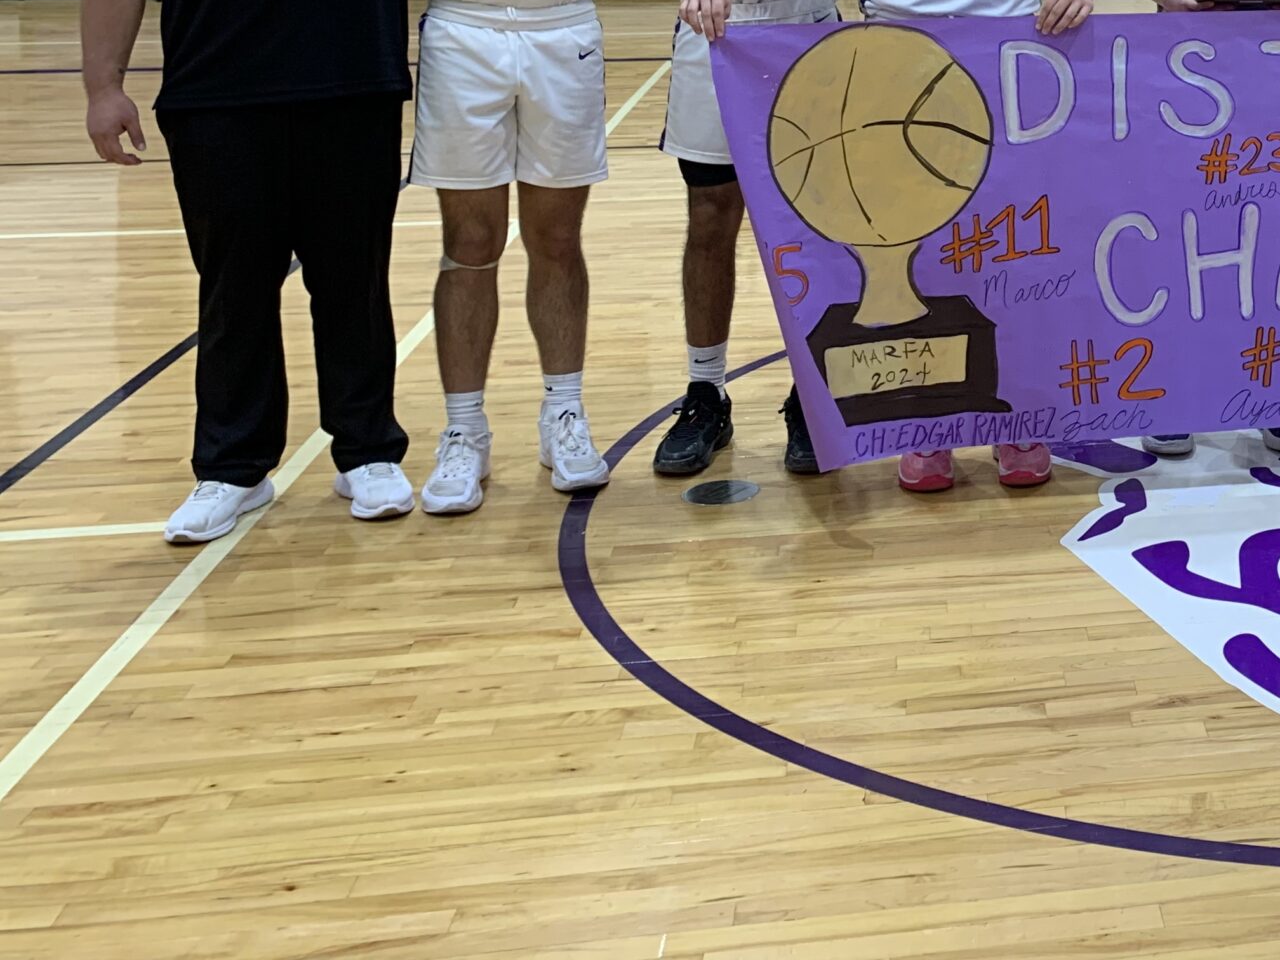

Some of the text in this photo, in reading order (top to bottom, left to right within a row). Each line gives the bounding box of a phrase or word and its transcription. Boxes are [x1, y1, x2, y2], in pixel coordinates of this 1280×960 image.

[940, 194, 1061, 274] #11
[983, 269, 1076, 308] Marco
[851, 341, 935, 368] MARFA
[1058, 337, 1166, 407] #2
[871, 361, 931, 391] 2024
[972, 407, 1056, 446] RAMIREZ
